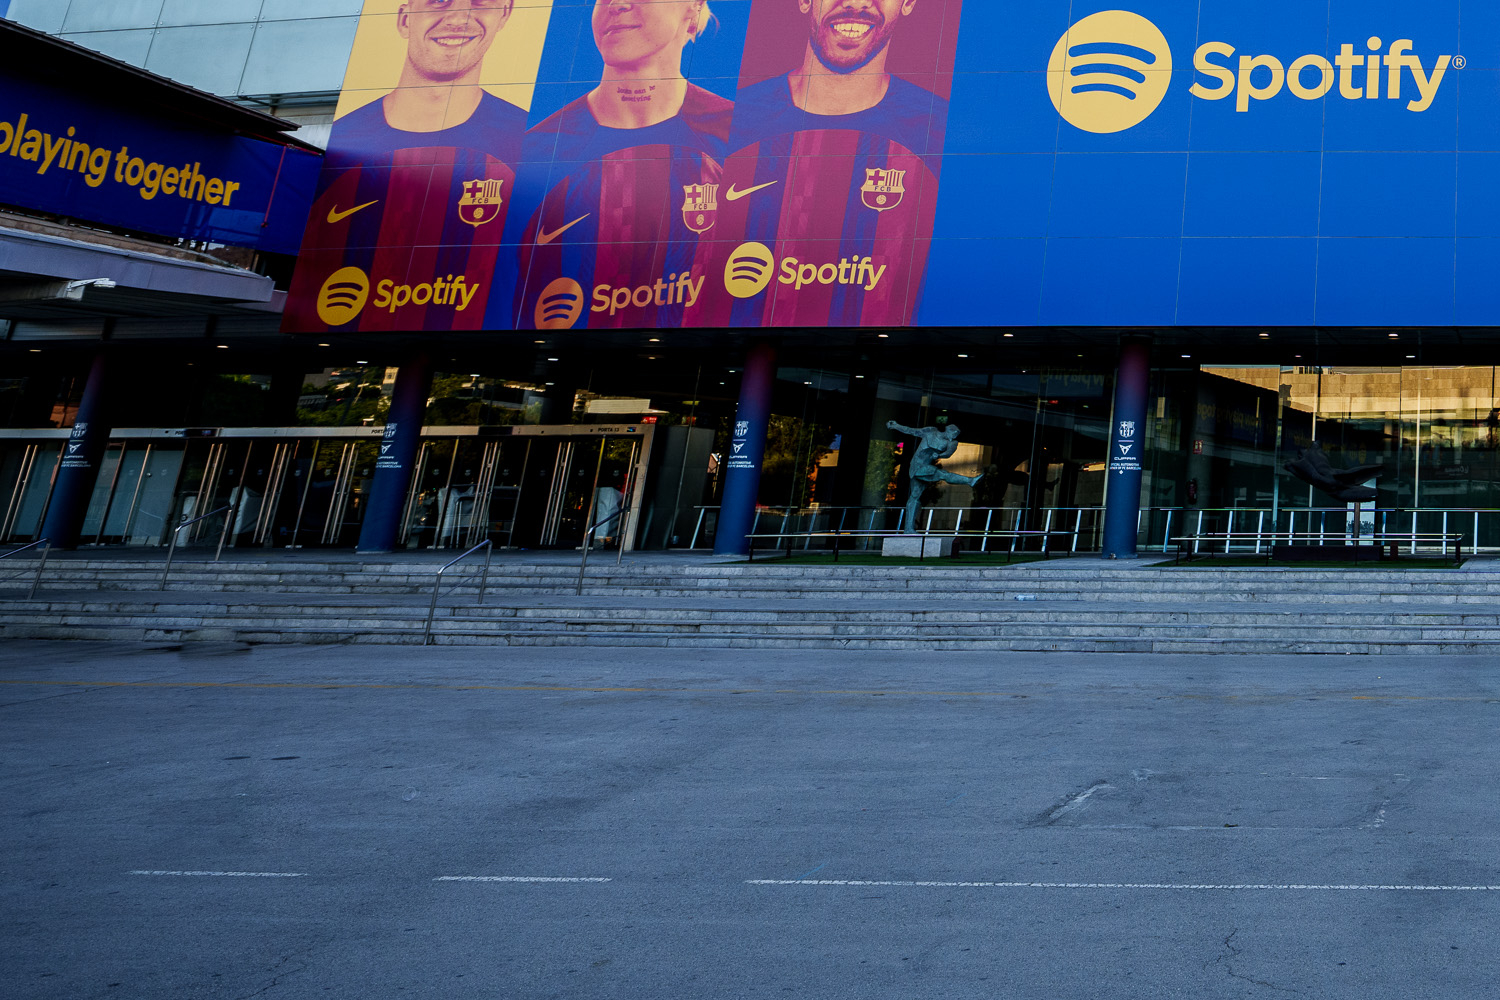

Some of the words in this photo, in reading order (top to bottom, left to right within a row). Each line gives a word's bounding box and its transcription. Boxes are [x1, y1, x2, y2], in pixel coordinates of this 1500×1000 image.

[114, 146, 240, 206] together
[471, 197, 490, 205] FCB
[779, 254, 887, 291] Spotify
[373, 274, 480, 313] Spotify
[590, 270, 706, 316] Spotify
